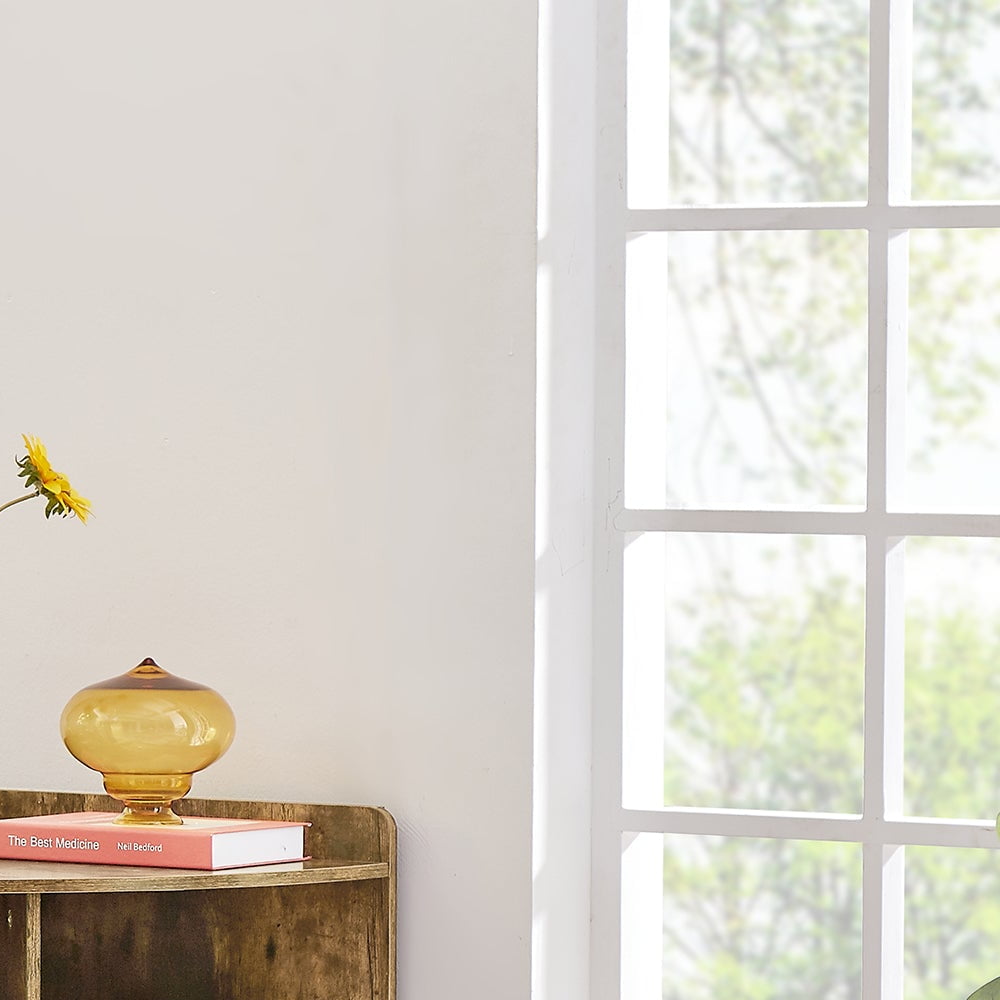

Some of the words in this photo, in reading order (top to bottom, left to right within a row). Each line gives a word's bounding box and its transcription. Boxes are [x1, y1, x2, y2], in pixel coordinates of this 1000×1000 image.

[8, 834, 27, 847] The
[30, 836, 53, 849] Best
[55, 837, 100, 851] Medicine
[117, 842, 132, 852] Neil
[133, 842, 163, 853] Bedford
